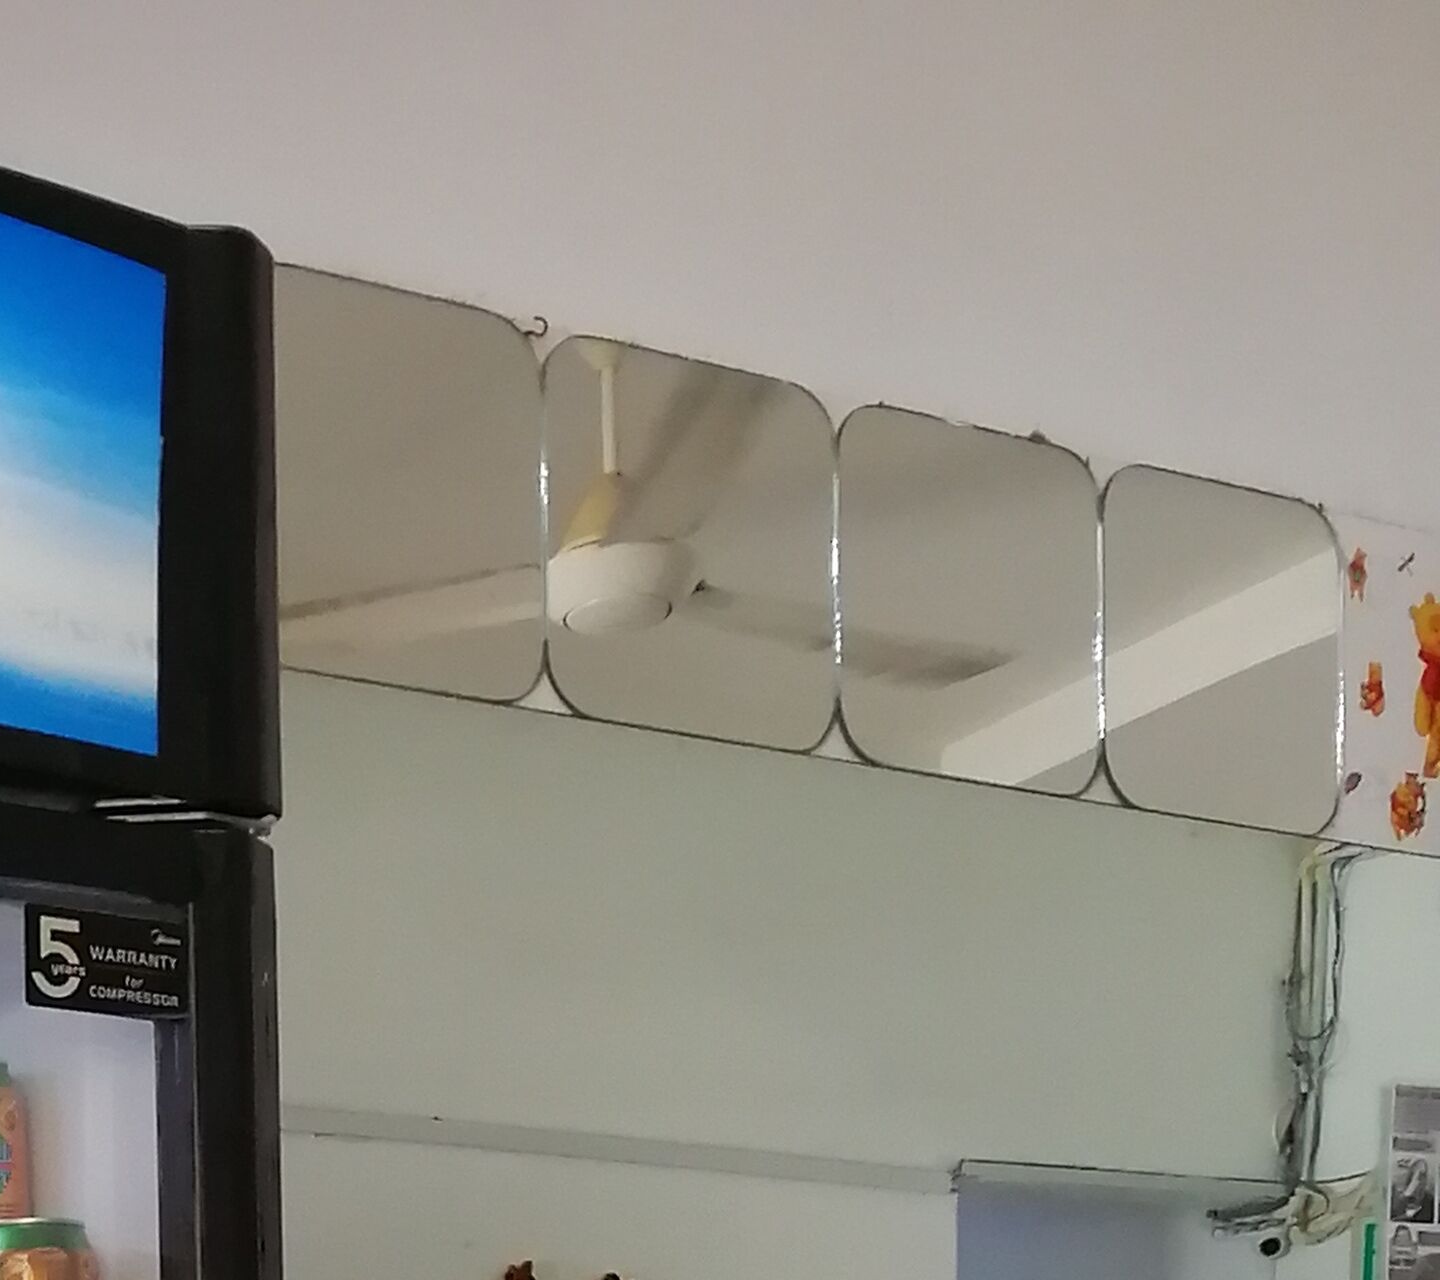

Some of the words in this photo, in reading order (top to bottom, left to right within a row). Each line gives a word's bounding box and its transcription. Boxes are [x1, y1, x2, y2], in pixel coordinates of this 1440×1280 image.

[31, 915, 81, 998] 5
[89, 944, 178, 971] WARRANTY
[124, 974, 145, 988] for
[88, 984, 180, 1008] COMPRESSOR
